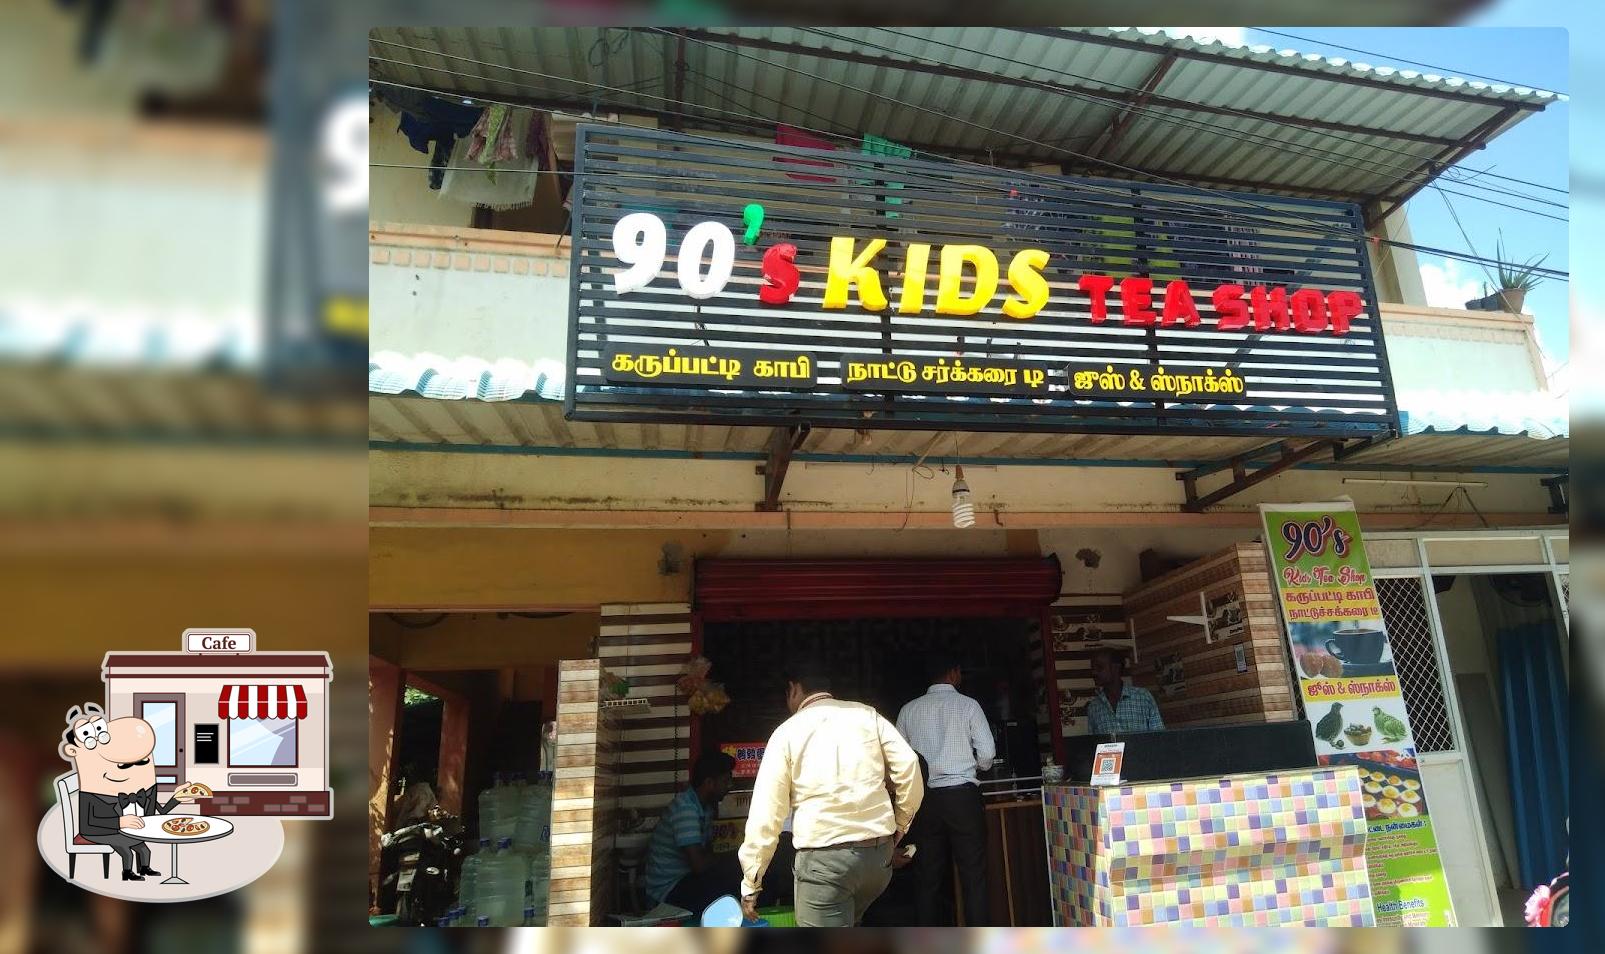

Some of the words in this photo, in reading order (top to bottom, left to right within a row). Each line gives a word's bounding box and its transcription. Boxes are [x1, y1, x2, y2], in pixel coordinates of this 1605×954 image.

[612, 203, 799, 305] 90's
[822, 236, 1051, 320] KIDS
[1078, 274, 1200, 328] TEA
[1212, 284, 1364, 336] SHOP
[611, 348, 741, 381] கருப்பட்டி
[753, 354, 810, 381] காபி
[846, 361, 918, 384] நாட்டு
[921, 358, 1018, 387] சர்க்கரை
[1129, 369, 1147, 391] &
[1150, 366, 1244, 398] ஸ்நாக்ஸ்
[1281, 515, 1352, 562] 90's
[1312, 565, 1335, 586] Tea
[1337, 565, 1367, 586] Shop
[1286, 589, 1343, 605] கருப்பட்டி
[1346, 587, 1375, 601] காபி
[1337, 681, 1346, 695] &
[1348, 678, 1397, 697] ஸ்நாக்ஸ்
